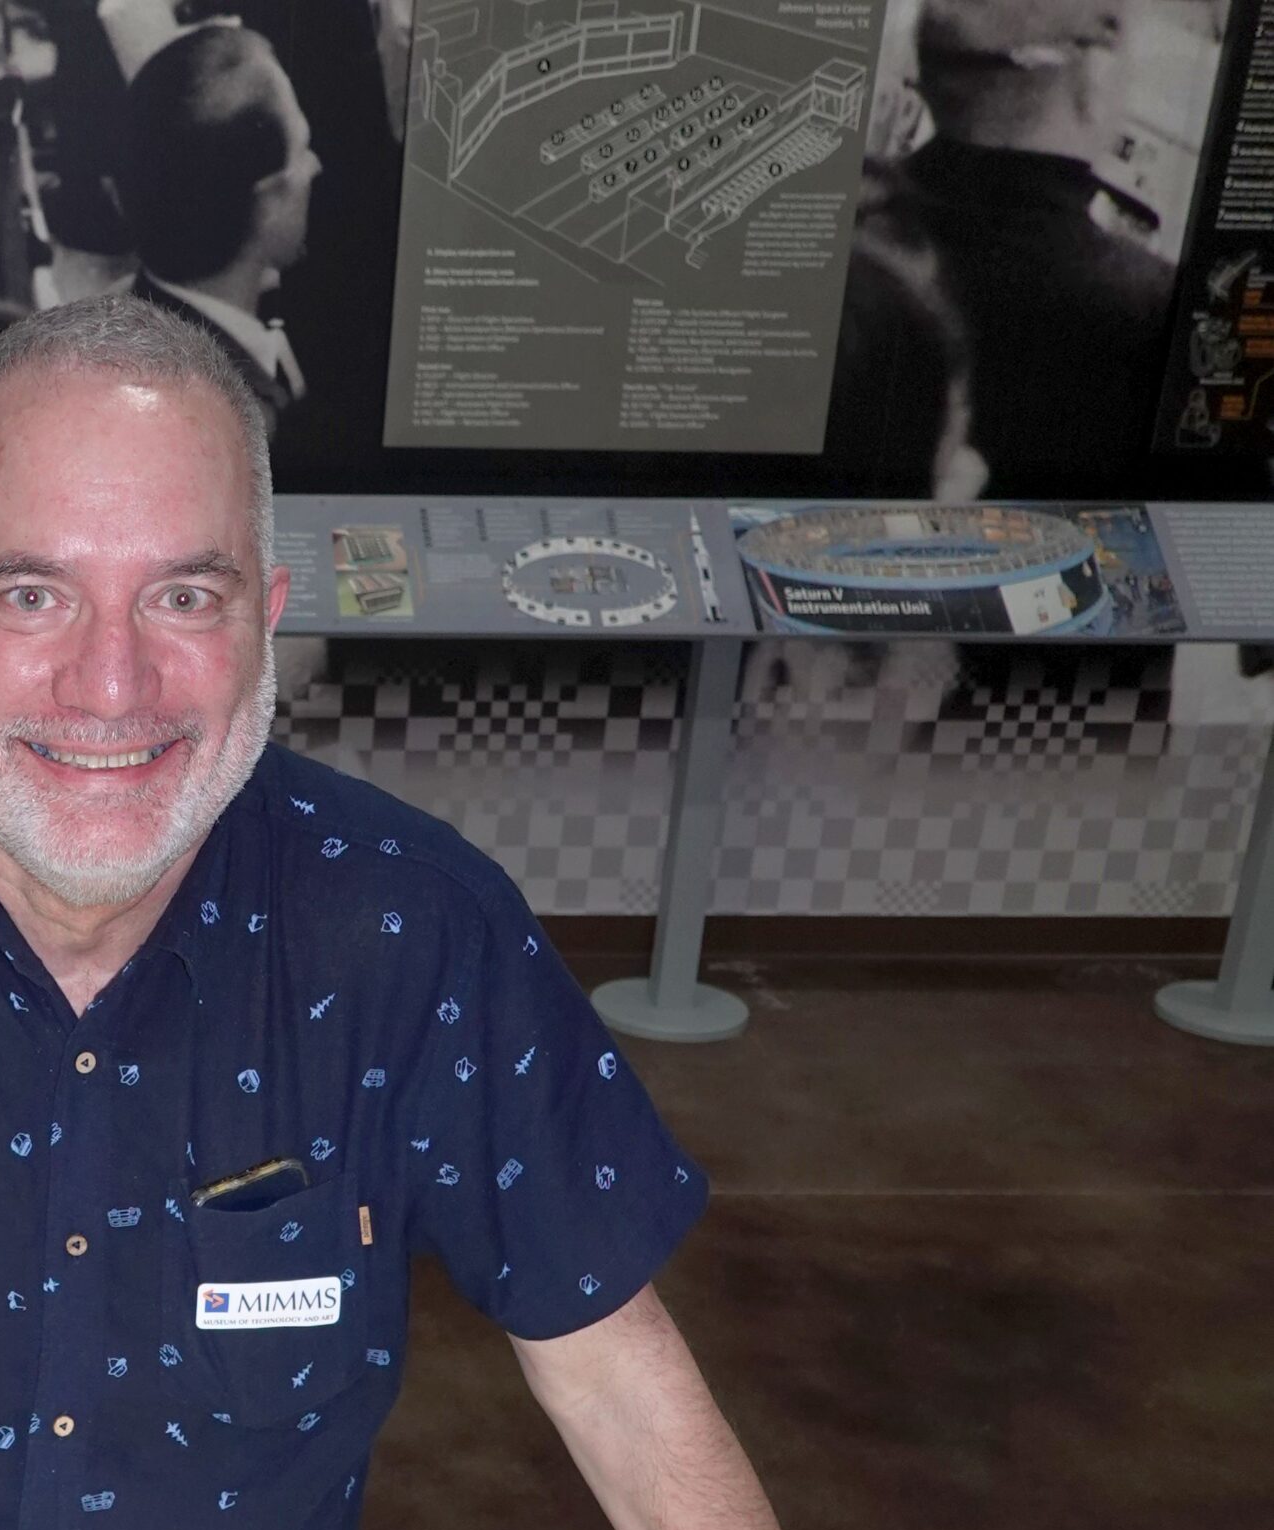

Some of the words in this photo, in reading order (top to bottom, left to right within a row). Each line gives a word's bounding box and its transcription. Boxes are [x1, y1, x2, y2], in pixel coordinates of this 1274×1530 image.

[815, 3, 841, 15] Space
[842, 3, 871, 14] Center
[784, 587, 831, 601] Saturn
[833, 587, 844, 600] V
[788, 600, 899, 614] Instrumentation
[901, 601, 931, 615] Unit
[238, 1288, 337, 1313] MIMMS
[251, 1317, 301, 1325] TECHNOLOGY
